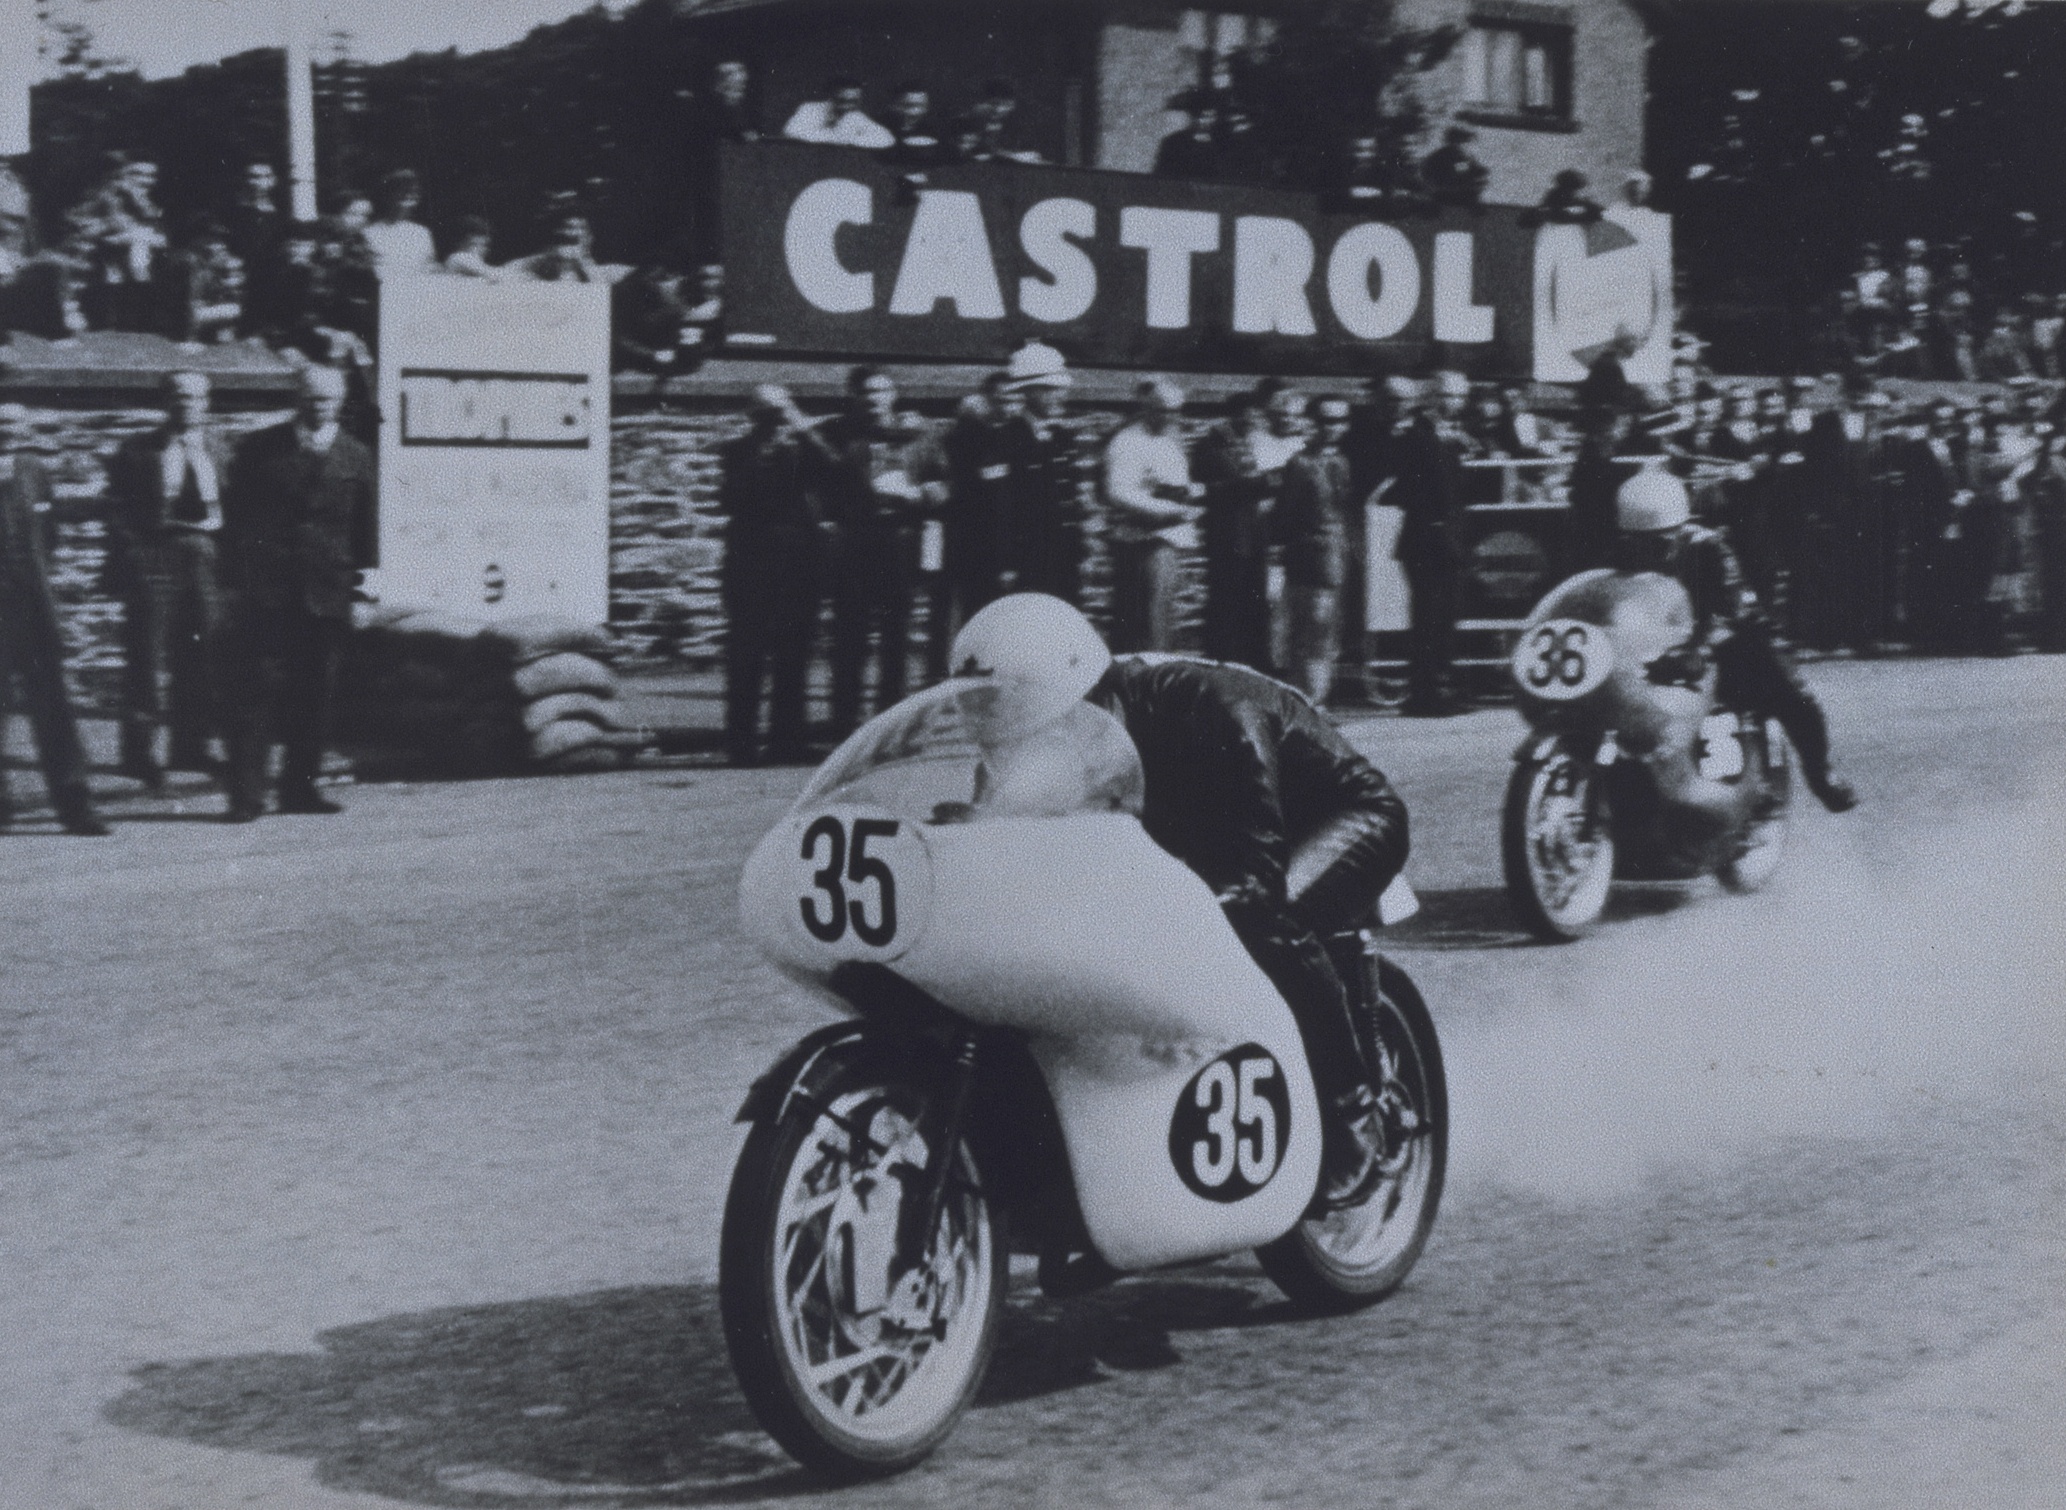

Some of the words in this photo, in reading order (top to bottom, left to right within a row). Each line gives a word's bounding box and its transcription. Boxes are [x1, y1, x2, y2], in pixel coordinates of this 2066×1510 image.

[784, 178, 1496, 343] CASTROL
[1527, 626, 1587, 687] 36
[800, 815, 899, 947] 35
[1192, 1057, 1277, 1188] 35
